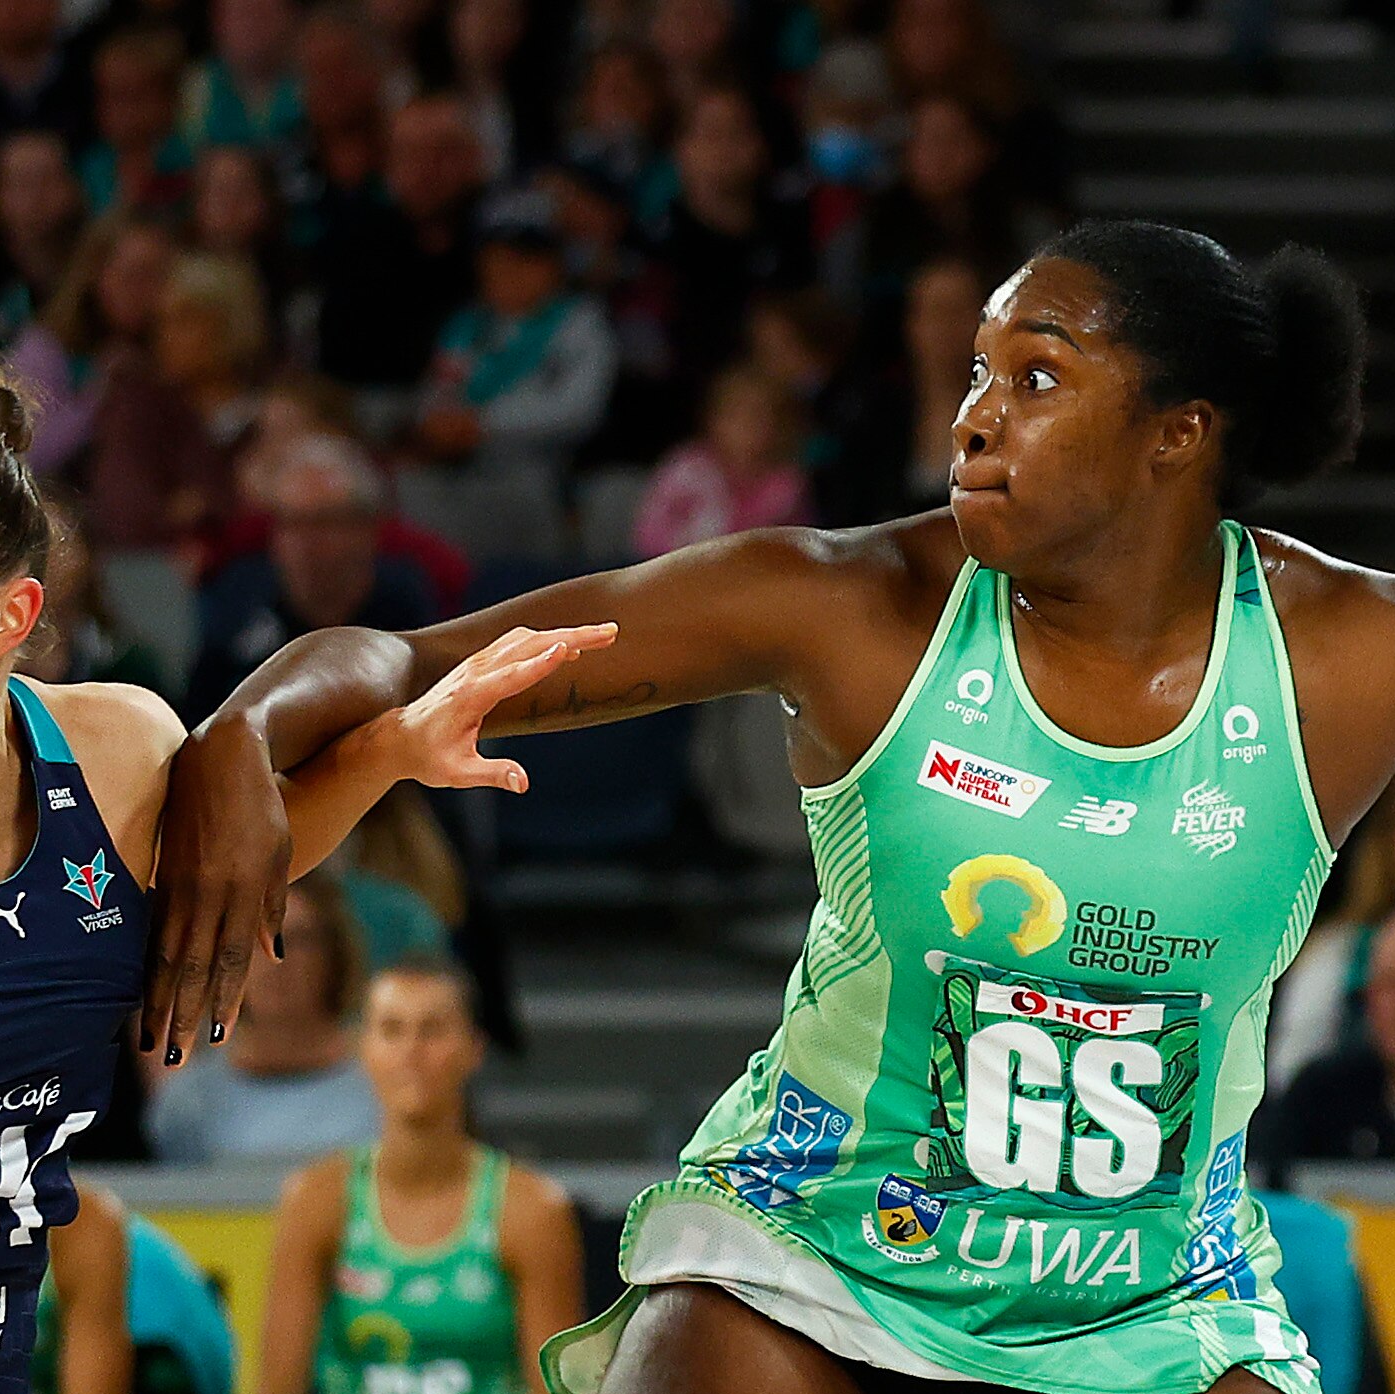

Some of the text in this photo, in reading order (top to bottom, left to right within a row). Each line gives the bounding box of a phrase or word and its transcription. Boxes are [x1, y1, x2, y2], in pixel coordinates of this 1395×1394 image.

[944, 700, 989, 725] origin
[1222, 744, 1267, 764] origin
[960, 771, 1000, 792] SUPER
[963, 761, 1018, 786] SUNCORP
[957, 781, 1011, 807] NETBALL
[1171, 806, 1246, 835] FEVER
[77, 913, 123, 933] VIXENS
[1075, 901, 1156, 931] GOLD
[1072, 924, 1220, 959] INDUSTRY
[1068, 947, 1171, 978] GROUP
[1055, 1003, 1133, 1031] HCF
[964, 1021, 1163, 1198] GS
[957, 1208, 1142, 1287] UWA
